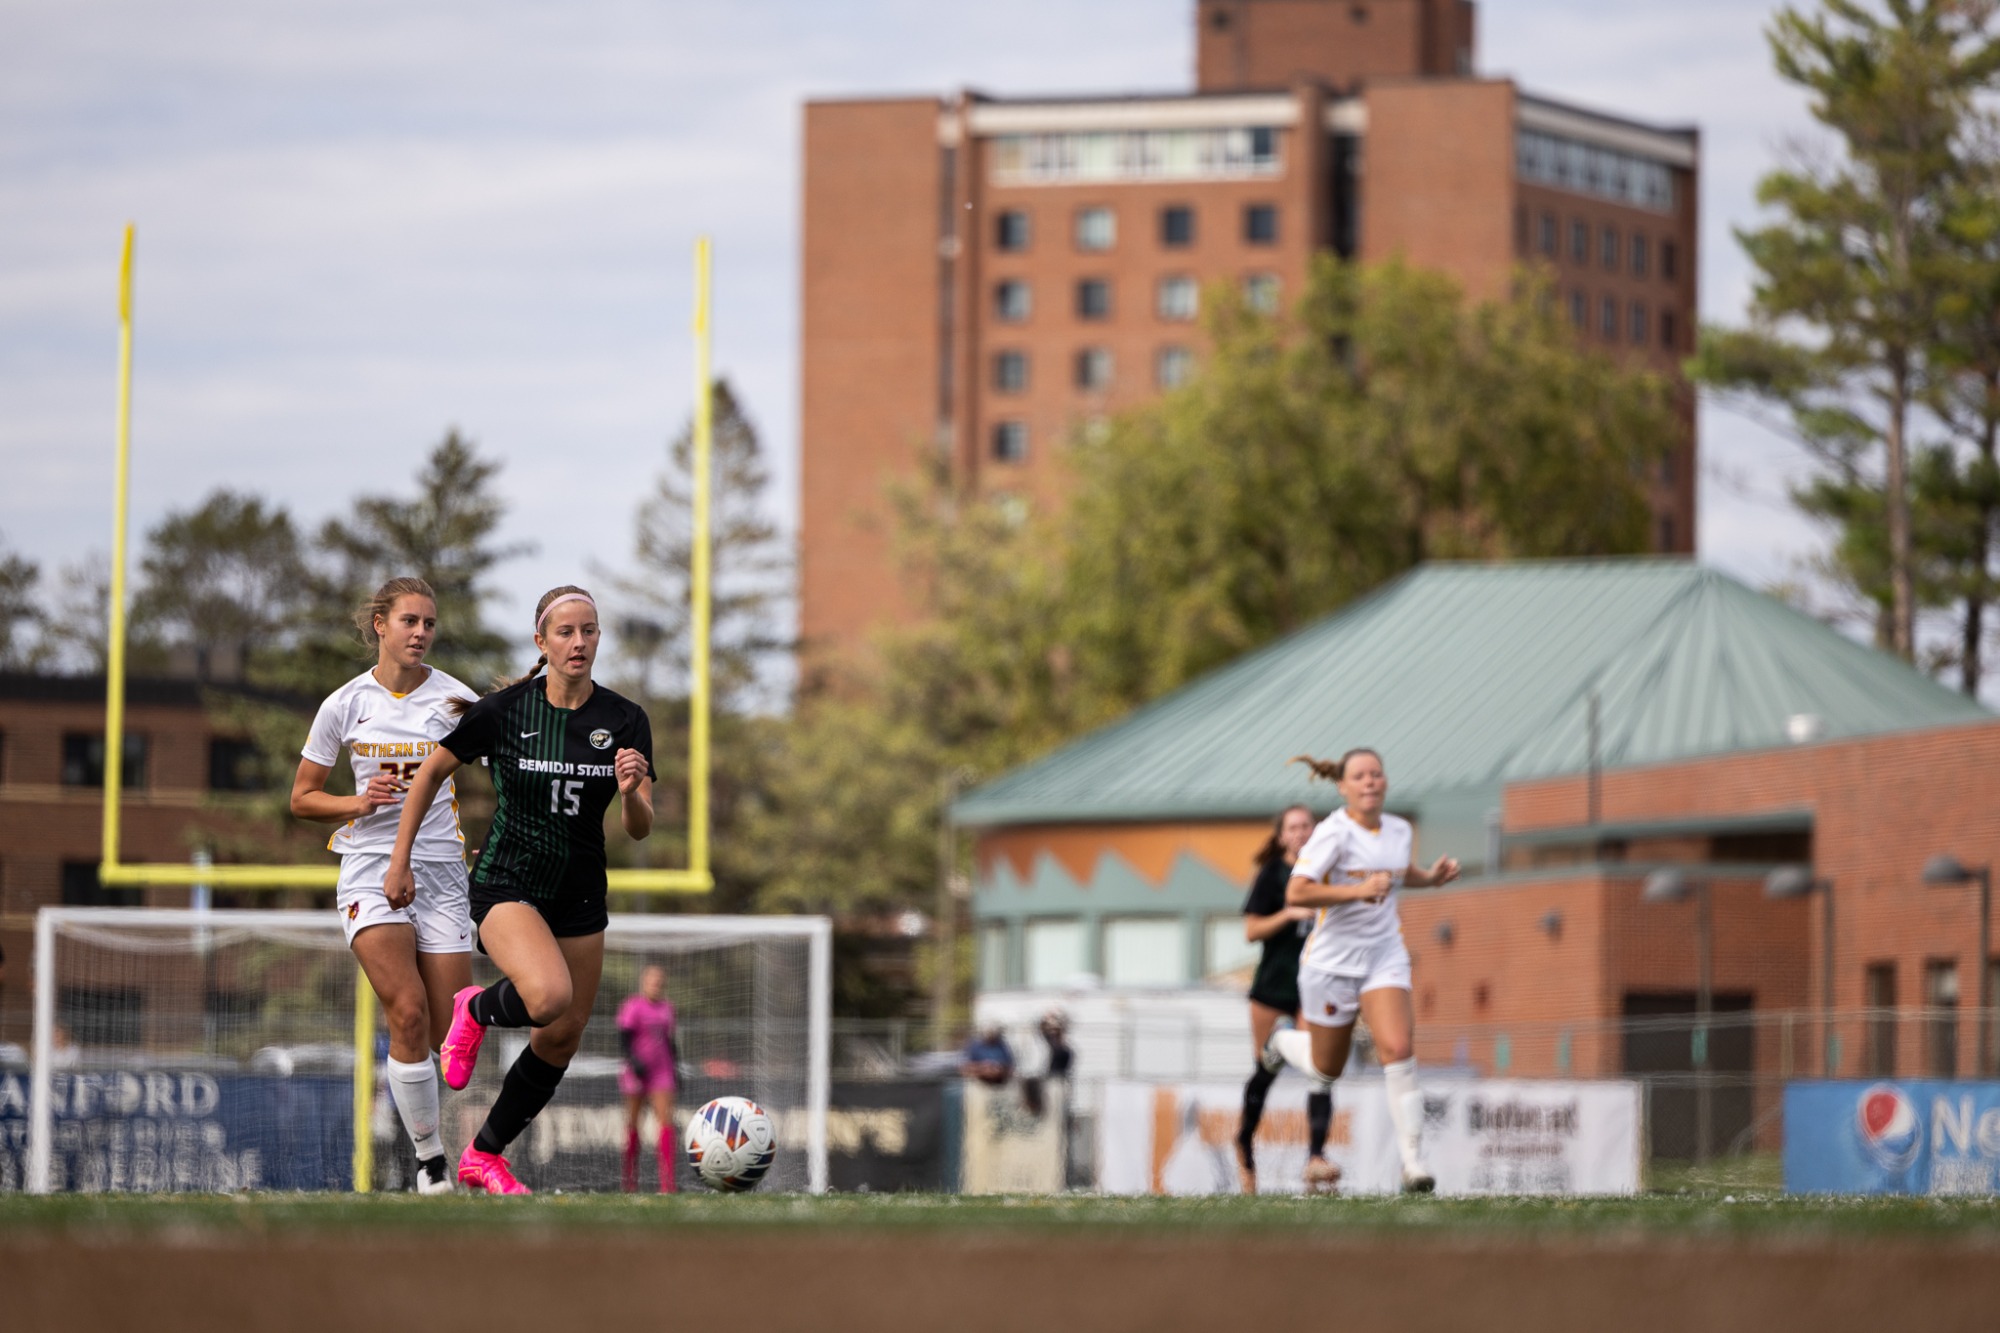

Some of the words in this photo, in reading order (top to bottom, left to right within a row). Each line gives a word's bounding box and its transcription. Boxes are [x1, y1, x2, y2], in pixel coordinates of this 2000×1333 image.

[518, 758, 574, 775] BEMIDJI
[577, 764, 614, 777] STATE
[550, 779, 584, 816] 15
